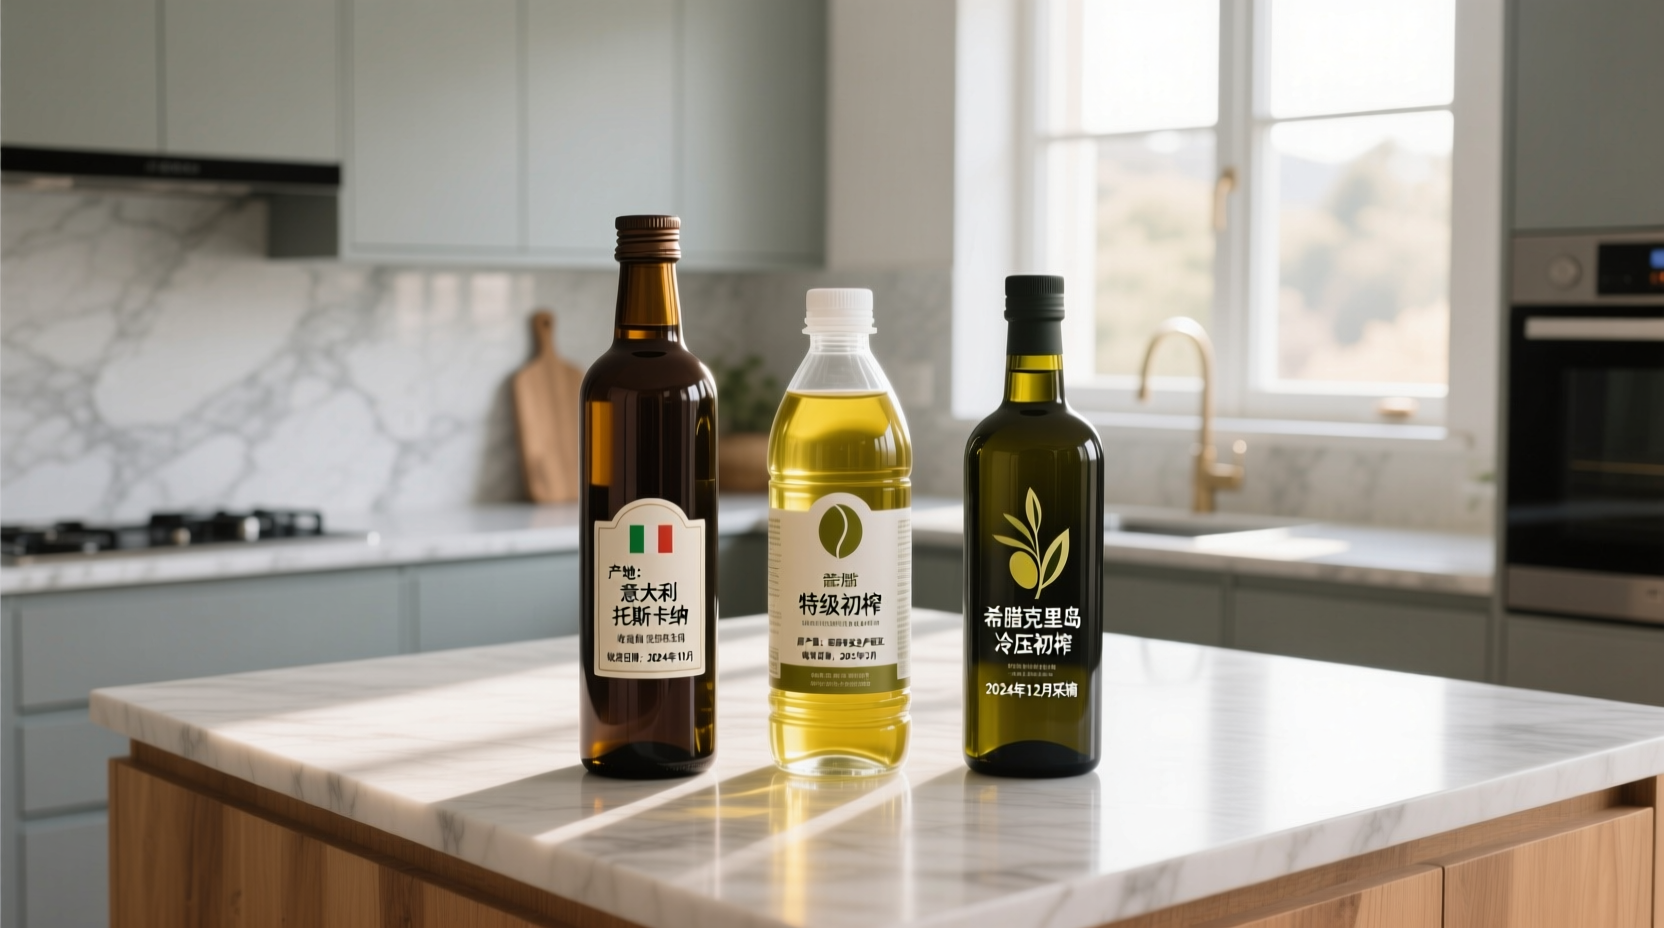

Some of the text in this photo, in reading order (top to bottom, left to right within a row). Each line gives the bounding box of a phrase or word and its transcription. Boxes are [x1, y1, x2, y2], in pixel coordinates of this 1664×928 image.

[620, 582, 677, 603] 意大利
[798, 592, 882, 617] 特级初榨
[612, 604, 689, 627] 托斯卡纳
[983, 605, 1081, 629] 希腊克里岛
[994, 631, 1073, 656] 冷压初榨
